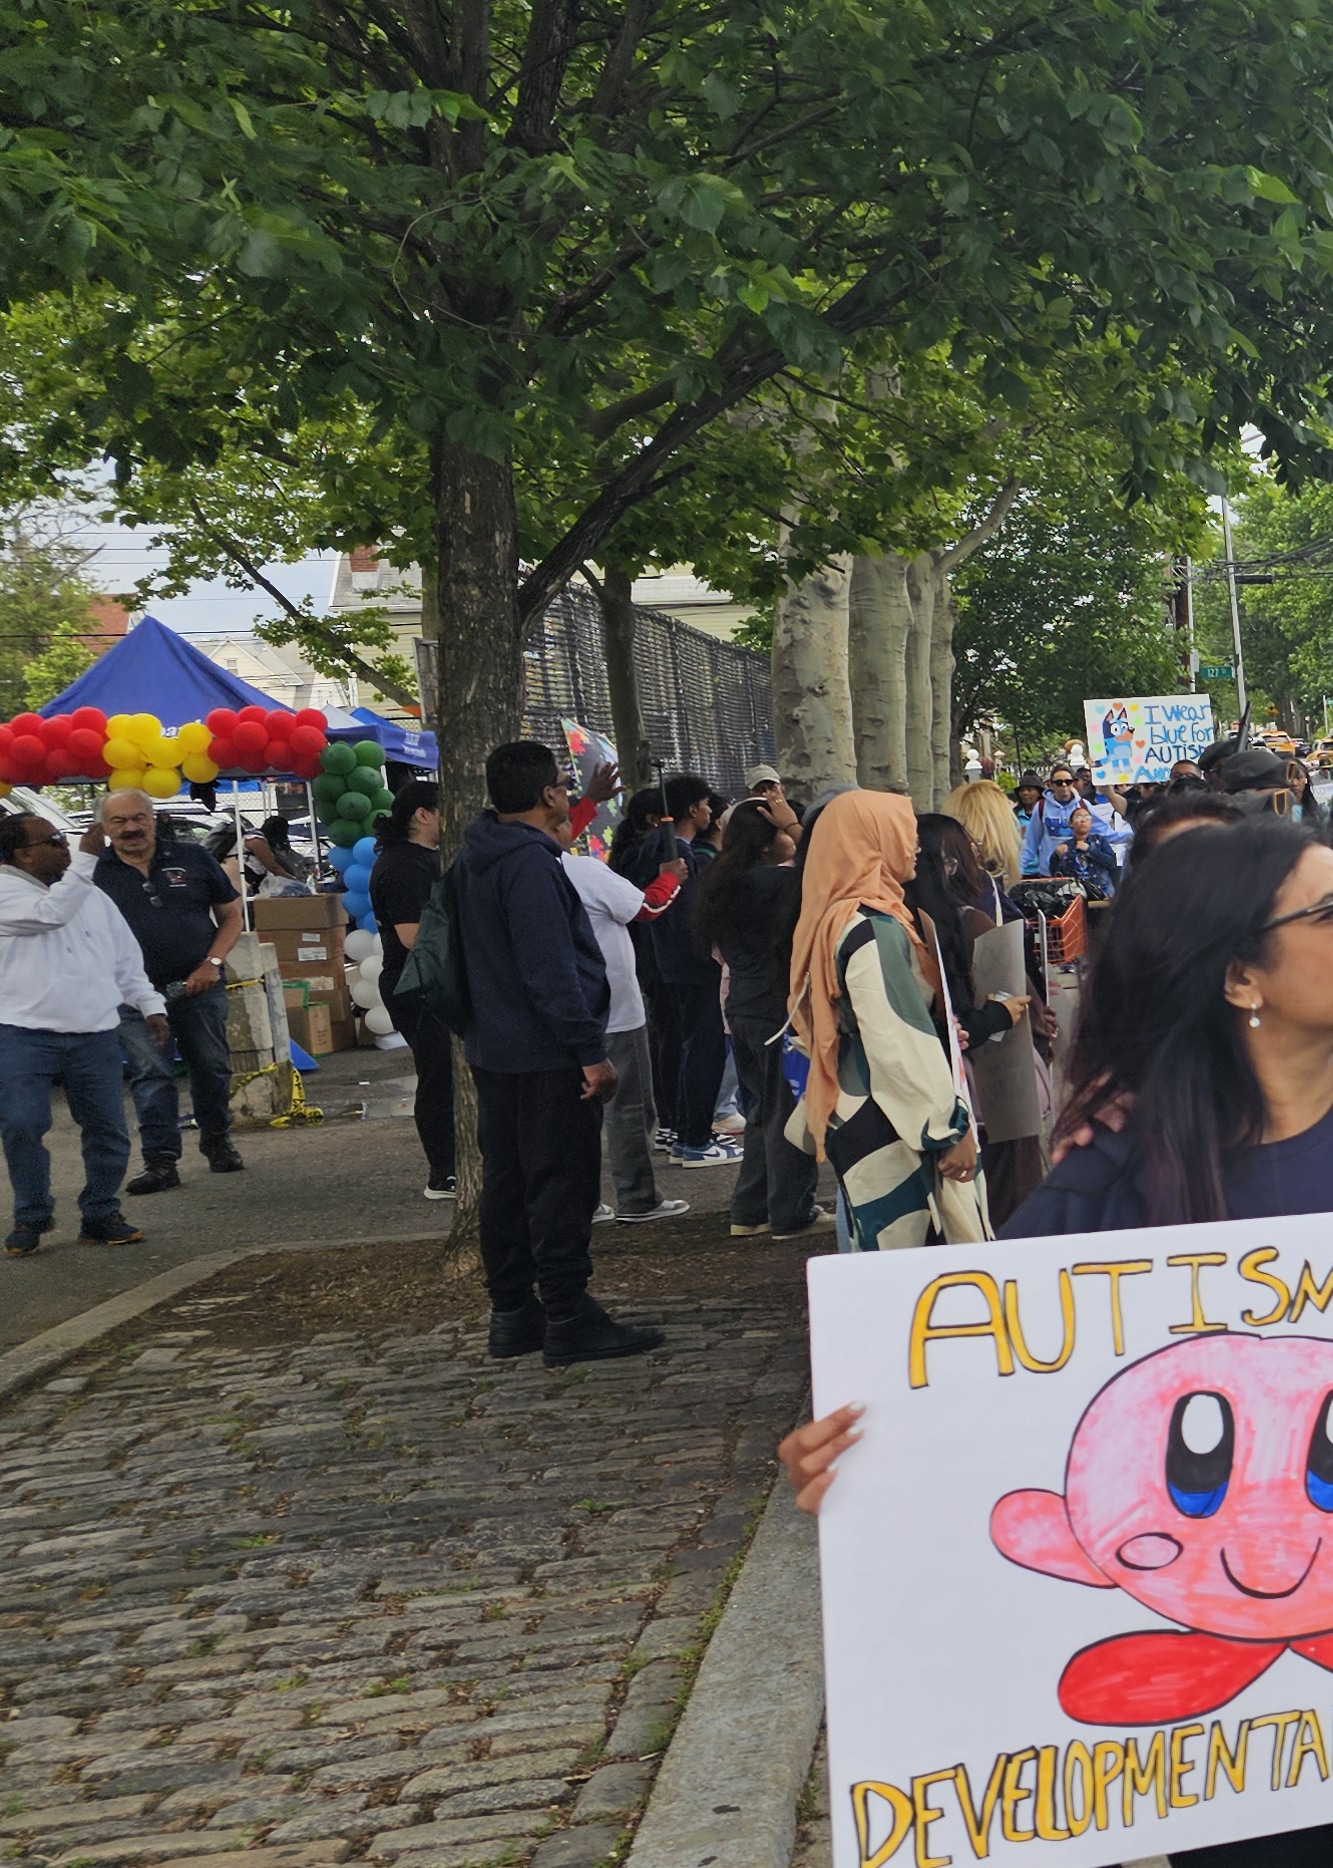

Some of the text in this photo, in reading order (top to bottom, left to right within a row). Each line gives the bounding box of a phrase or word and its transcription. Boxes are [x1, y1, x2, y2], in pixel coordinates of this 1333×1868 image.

[1207, 668, 1219, 677] 127
[1144, 705, 1161, 724] I
[1150, 725, 1187, 744] blue
